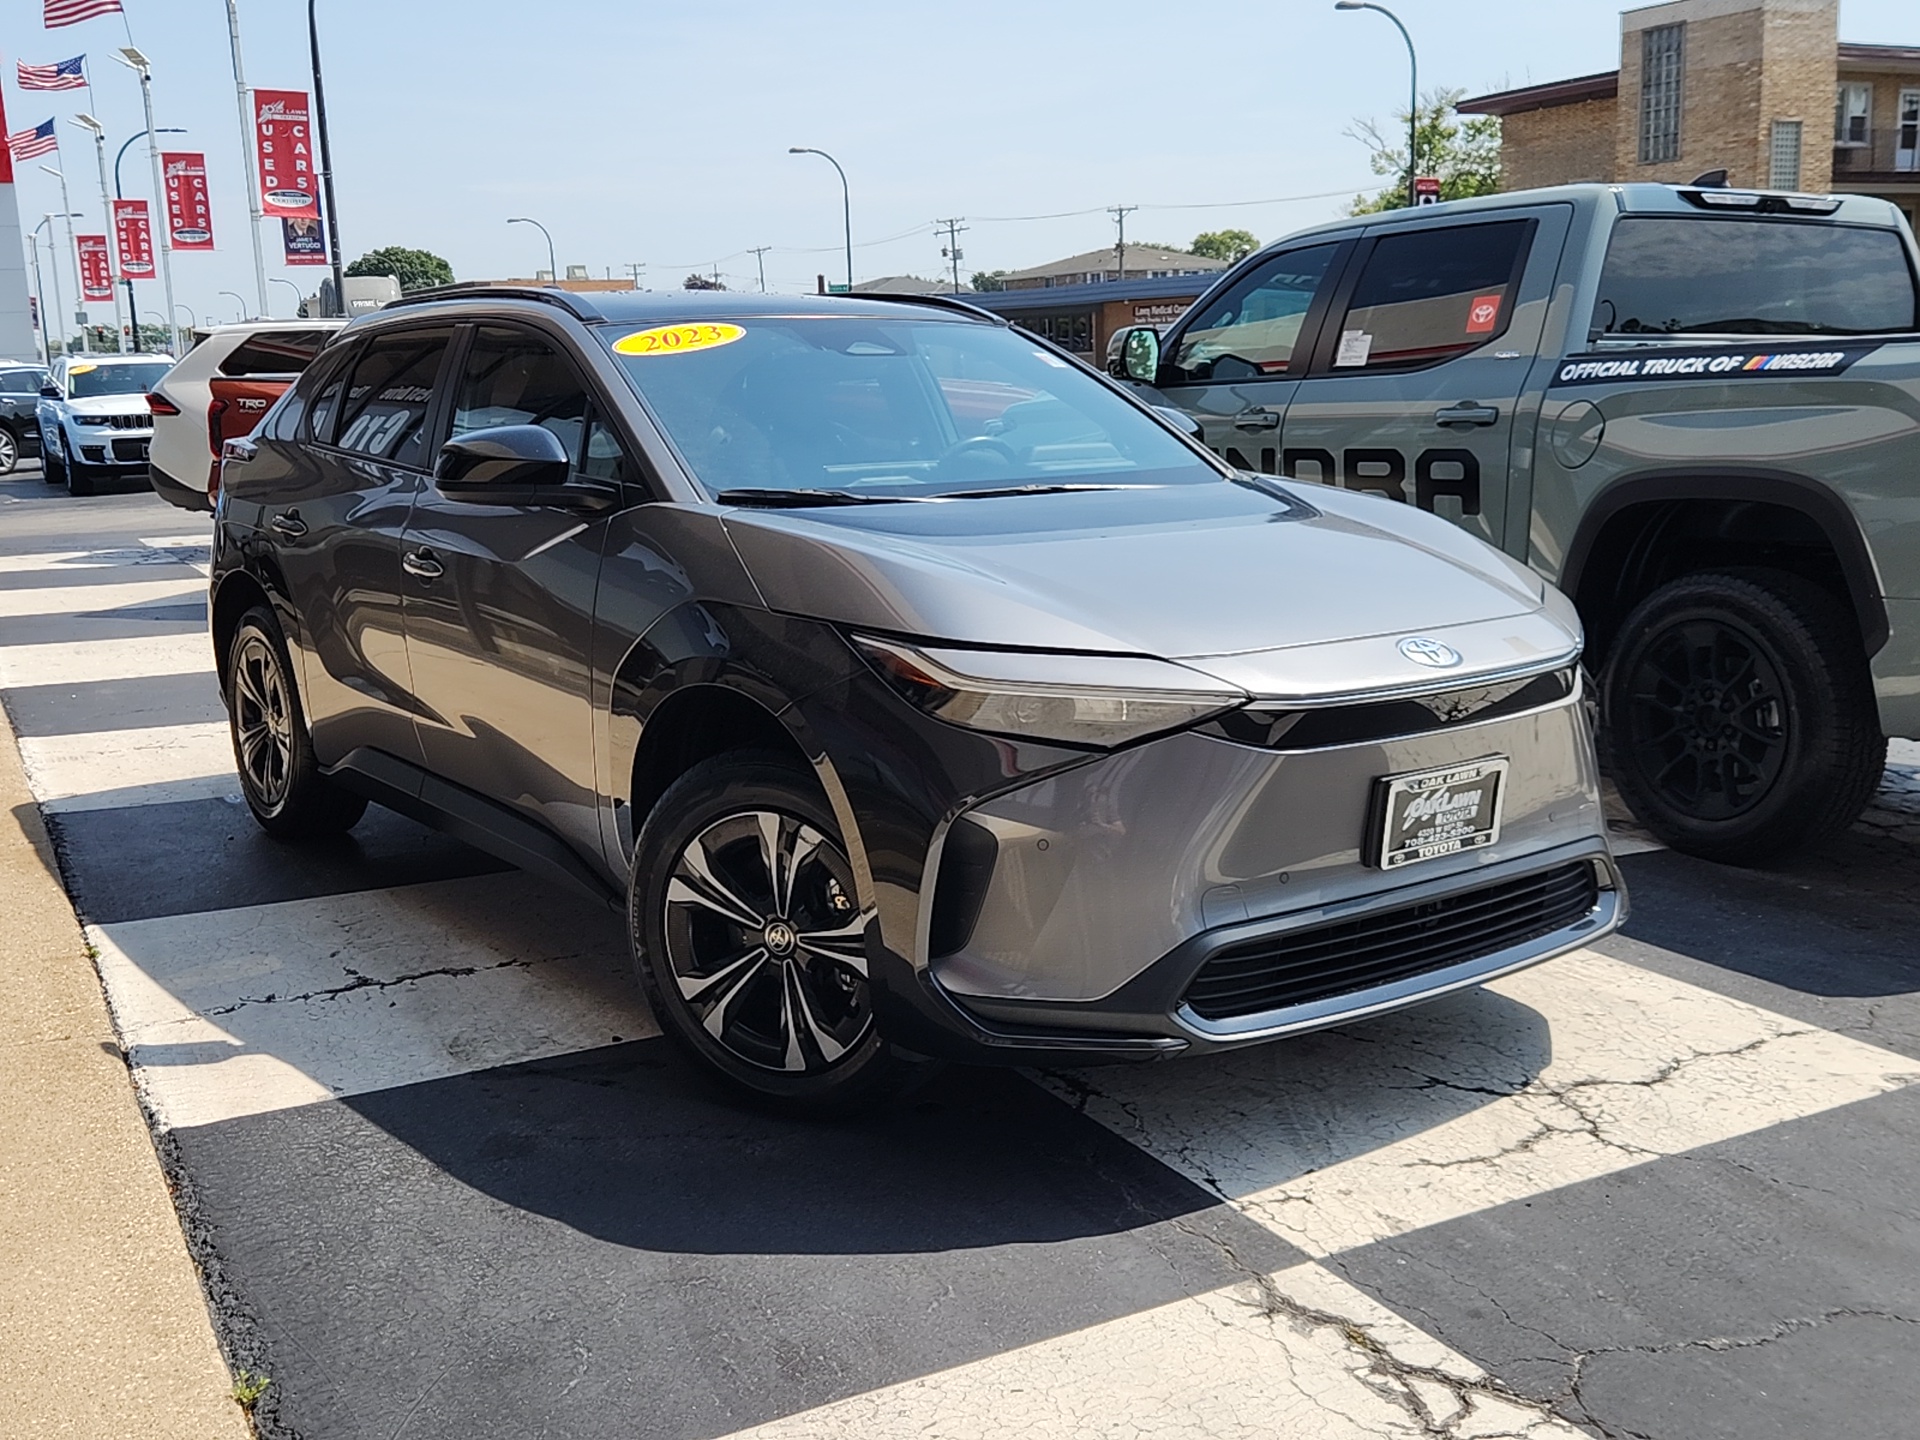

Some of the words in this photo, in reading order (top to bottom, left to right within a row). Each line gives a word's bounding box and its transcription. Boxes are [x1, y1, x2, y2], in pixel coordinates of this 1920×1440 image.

[262, 124, 278, 187] USED
[292, 126, 307, 188] CARS
[169, 178, 183, 227] USED
[193, 178, 206, 228] CARS
[118, 220, 131, 260] USED
[138, 220, 149, 261] CARS
[81, 252, 92, 286] USED
[98, 252, 109, 286] CARS
[641, 326, 721, 352] 2023
[1560, 359, 1637, 381] OFFICIAL
[1642, 357, 1712, 375] TRUCK
[1709, 355, 1744, 372] OF
[1769, 352, 1844, 370] NASCAR
[1420, 777, 1445, 788] OAK
[1445, 768, 1478, 784] LAWN
[1418, 840, 1461, 858] TOYOTA
